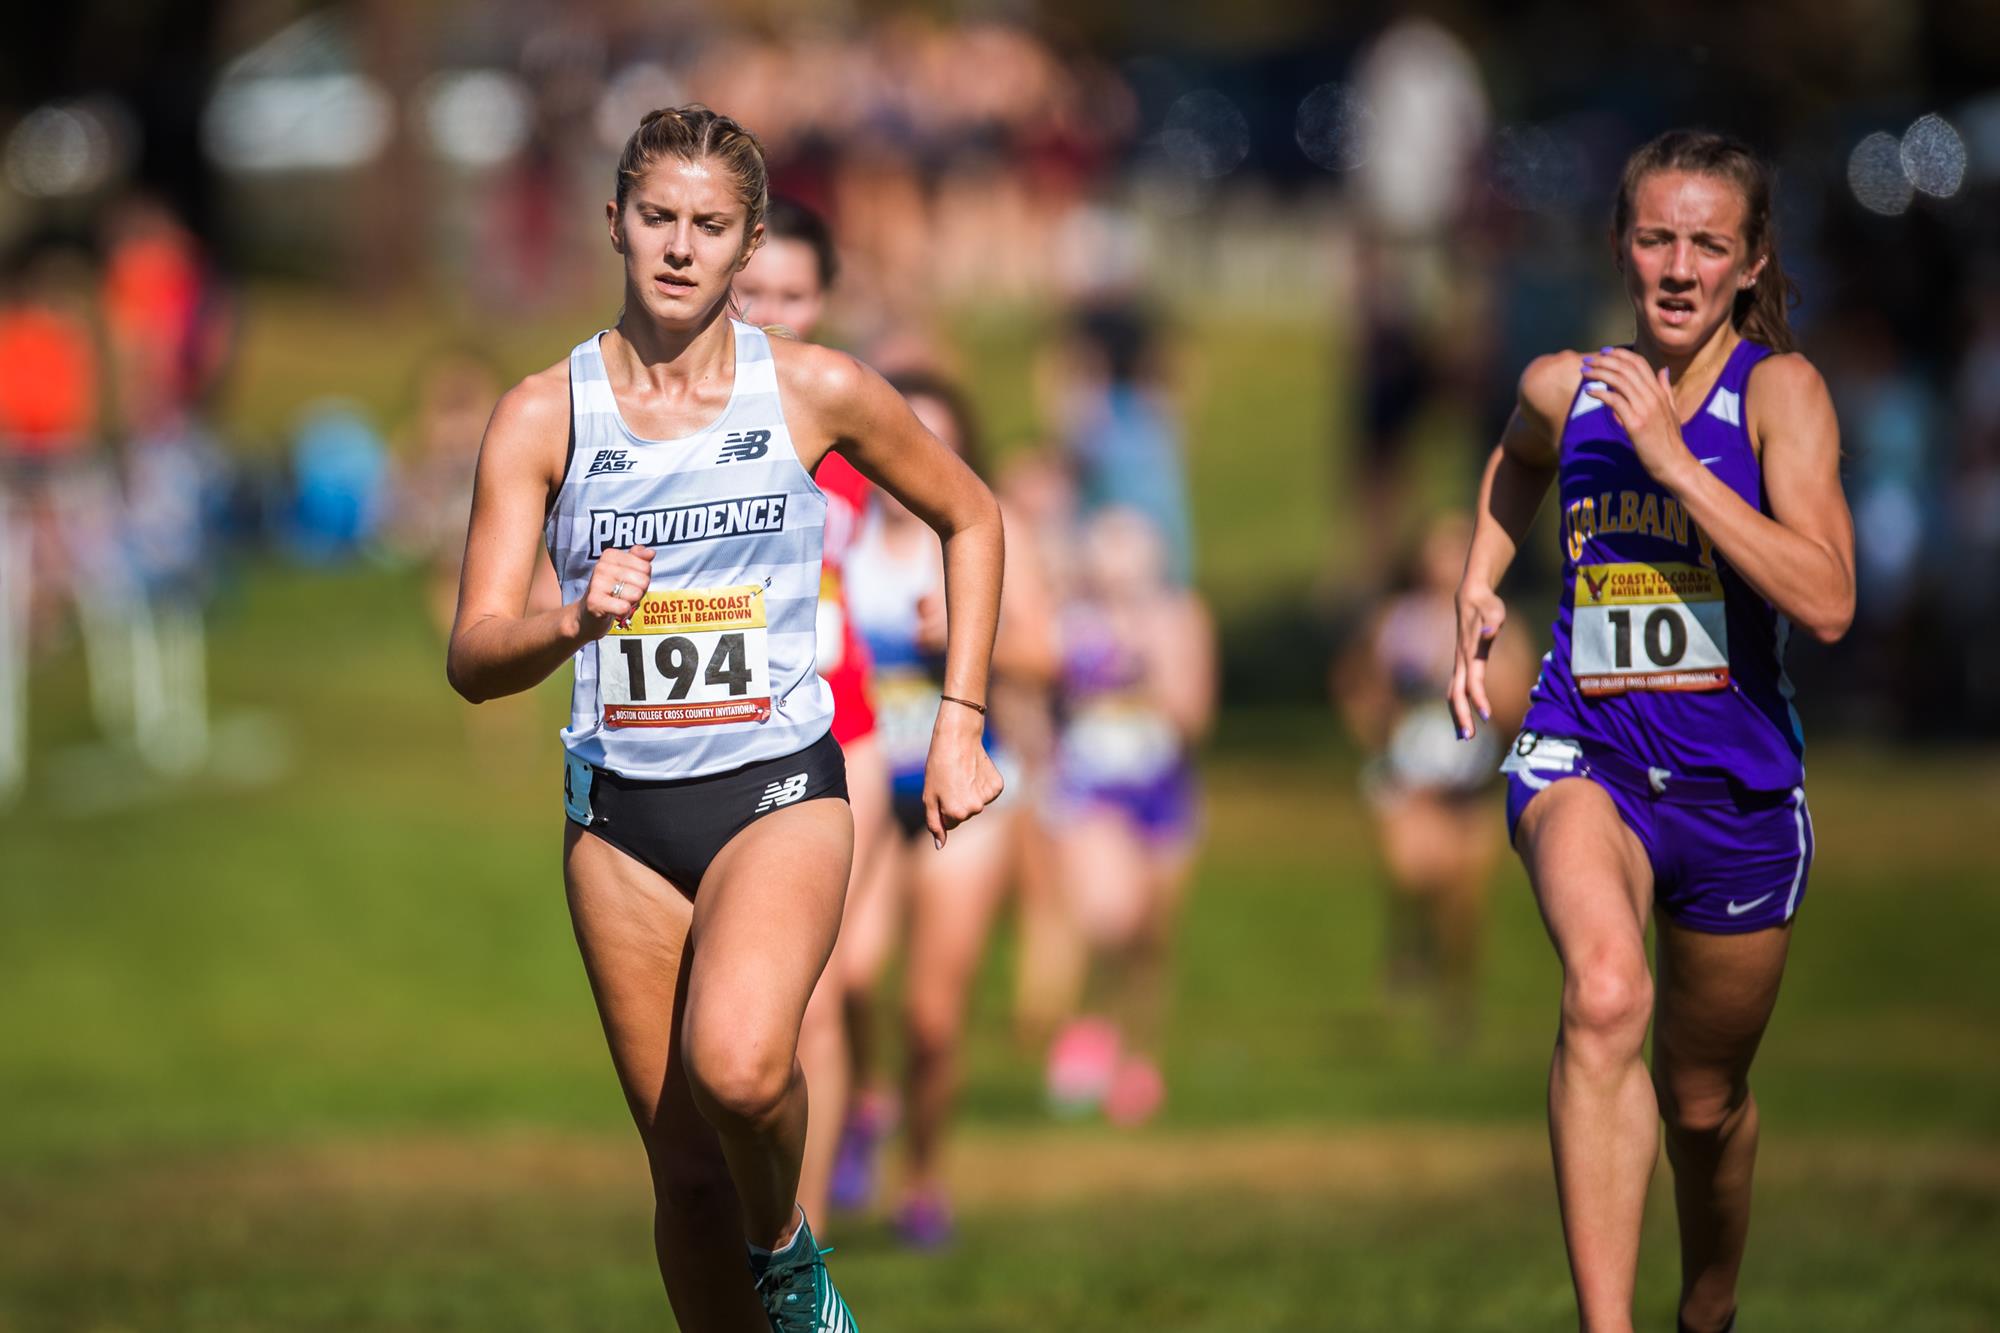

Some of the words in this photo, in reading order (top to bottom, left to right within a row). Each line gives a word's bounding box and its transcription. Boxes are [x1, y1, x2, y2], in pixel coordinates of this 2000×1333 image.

[594, 449, 628, 461] BIG
[589, 461, 637, 473] EAST
[590, 494, 787, 559] PROVIDENCE
[643, 595, 750, 614] COAST-TO-COAST
[644, 614, 677, 625] BATTLE
[681, 613, 691, 623] IN
[695, 609, 752, 622] BEANTOWN
[1608, 607, 1687, 668] 10
[620, 633, 752, 701] 194
[616, 710, 637, 720] BOSTON
[637, 710, 663, 720] COLLEGE
[663, 710, 684, 720] CROSS
[685, 708, 714, 719] COUNTRY
[715, 704, 756, 717] INVITATIONAL
